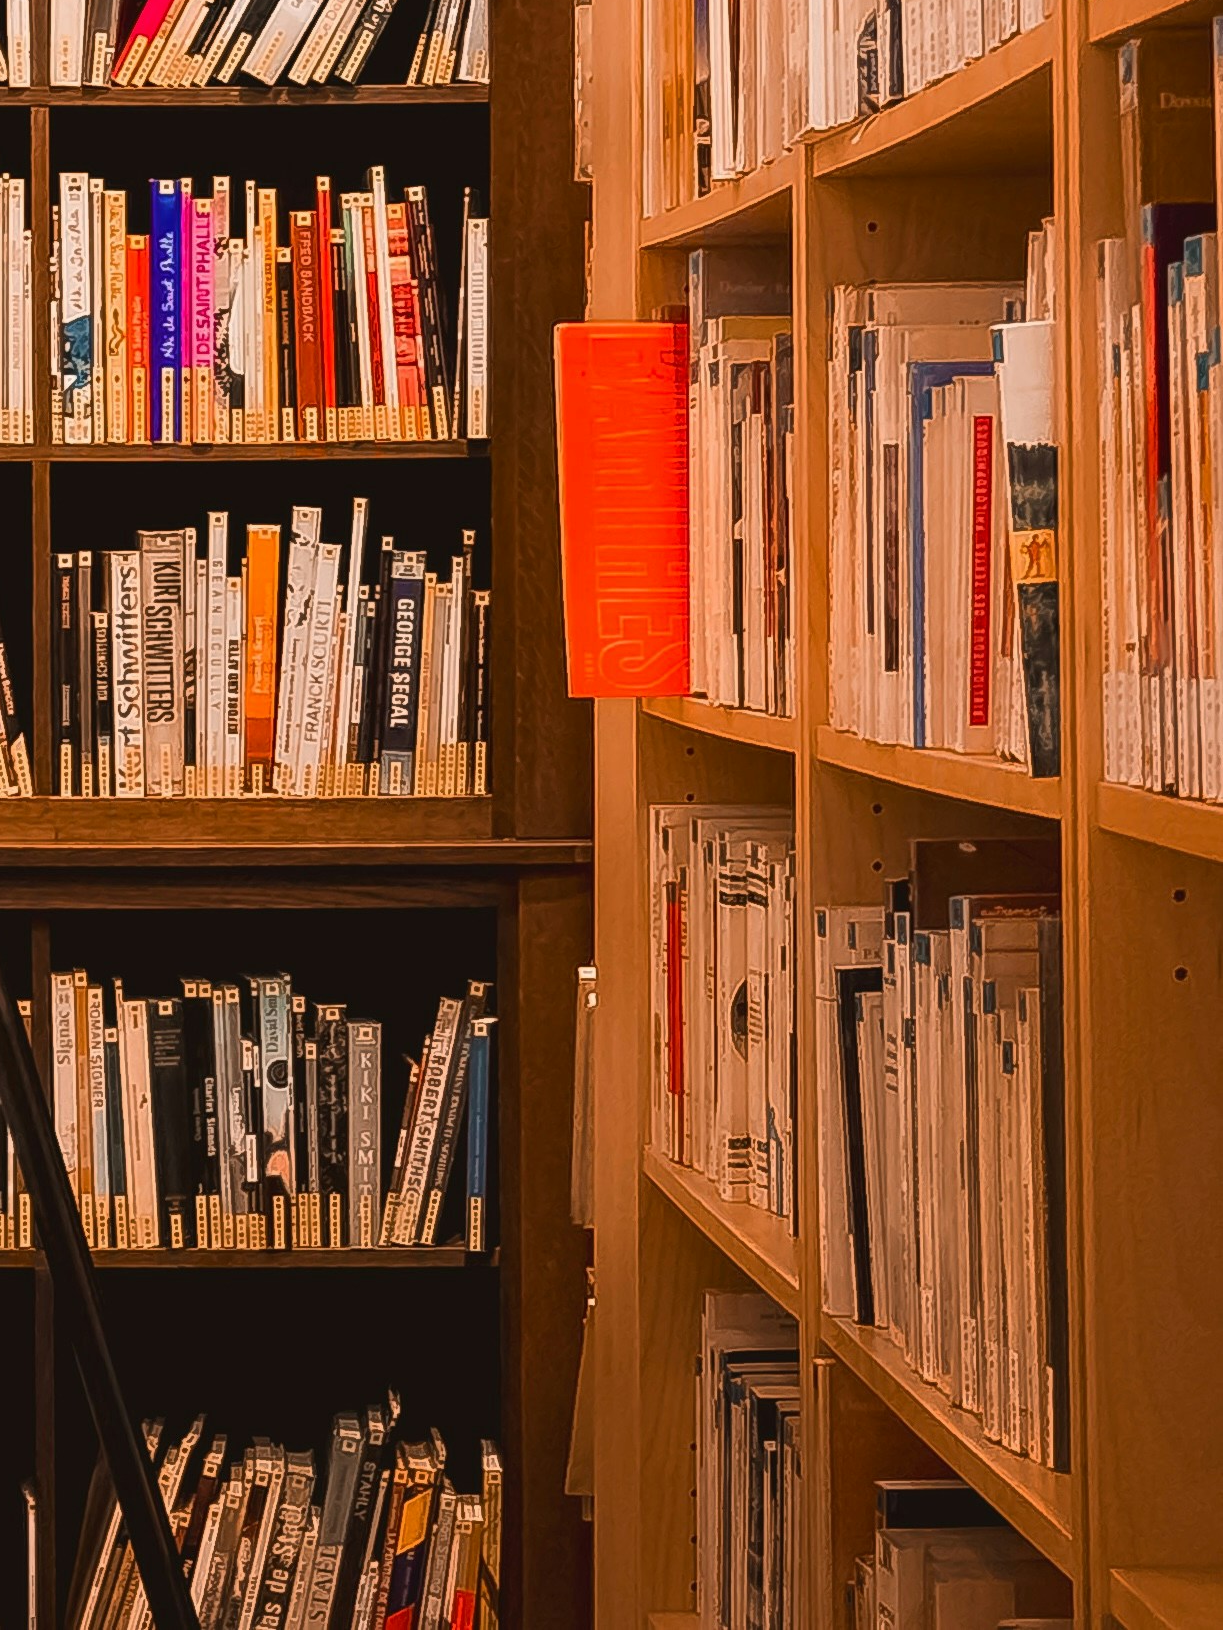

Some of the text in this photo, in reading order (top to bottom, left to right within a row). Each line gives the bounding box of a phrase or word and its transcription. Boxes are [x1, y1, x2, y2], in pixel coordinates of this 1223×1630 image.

[300, 231, 313, 267] FRED
[196, 277, 211, 329] SAINT
[196, 330, 211, 357] DE
[116, 566, 141, 719] Schwitters
[145, 560, 181, 724] KURT SCHWITTERS
[303, 599, 332, 743] FRANCK SCURTI
[388, 598, 415, 728] GEORGE SEGAL
[55, 1010, 72, 1065] Signac
[265, 1019, 279, 1053] David
[360, 1052, 372, 1120] KIKI
[420, 1054, 446, 1121] ROBERT
[353, 1461, 377, 1522] STAHLY
[265, 1569, 289, 1594] de
